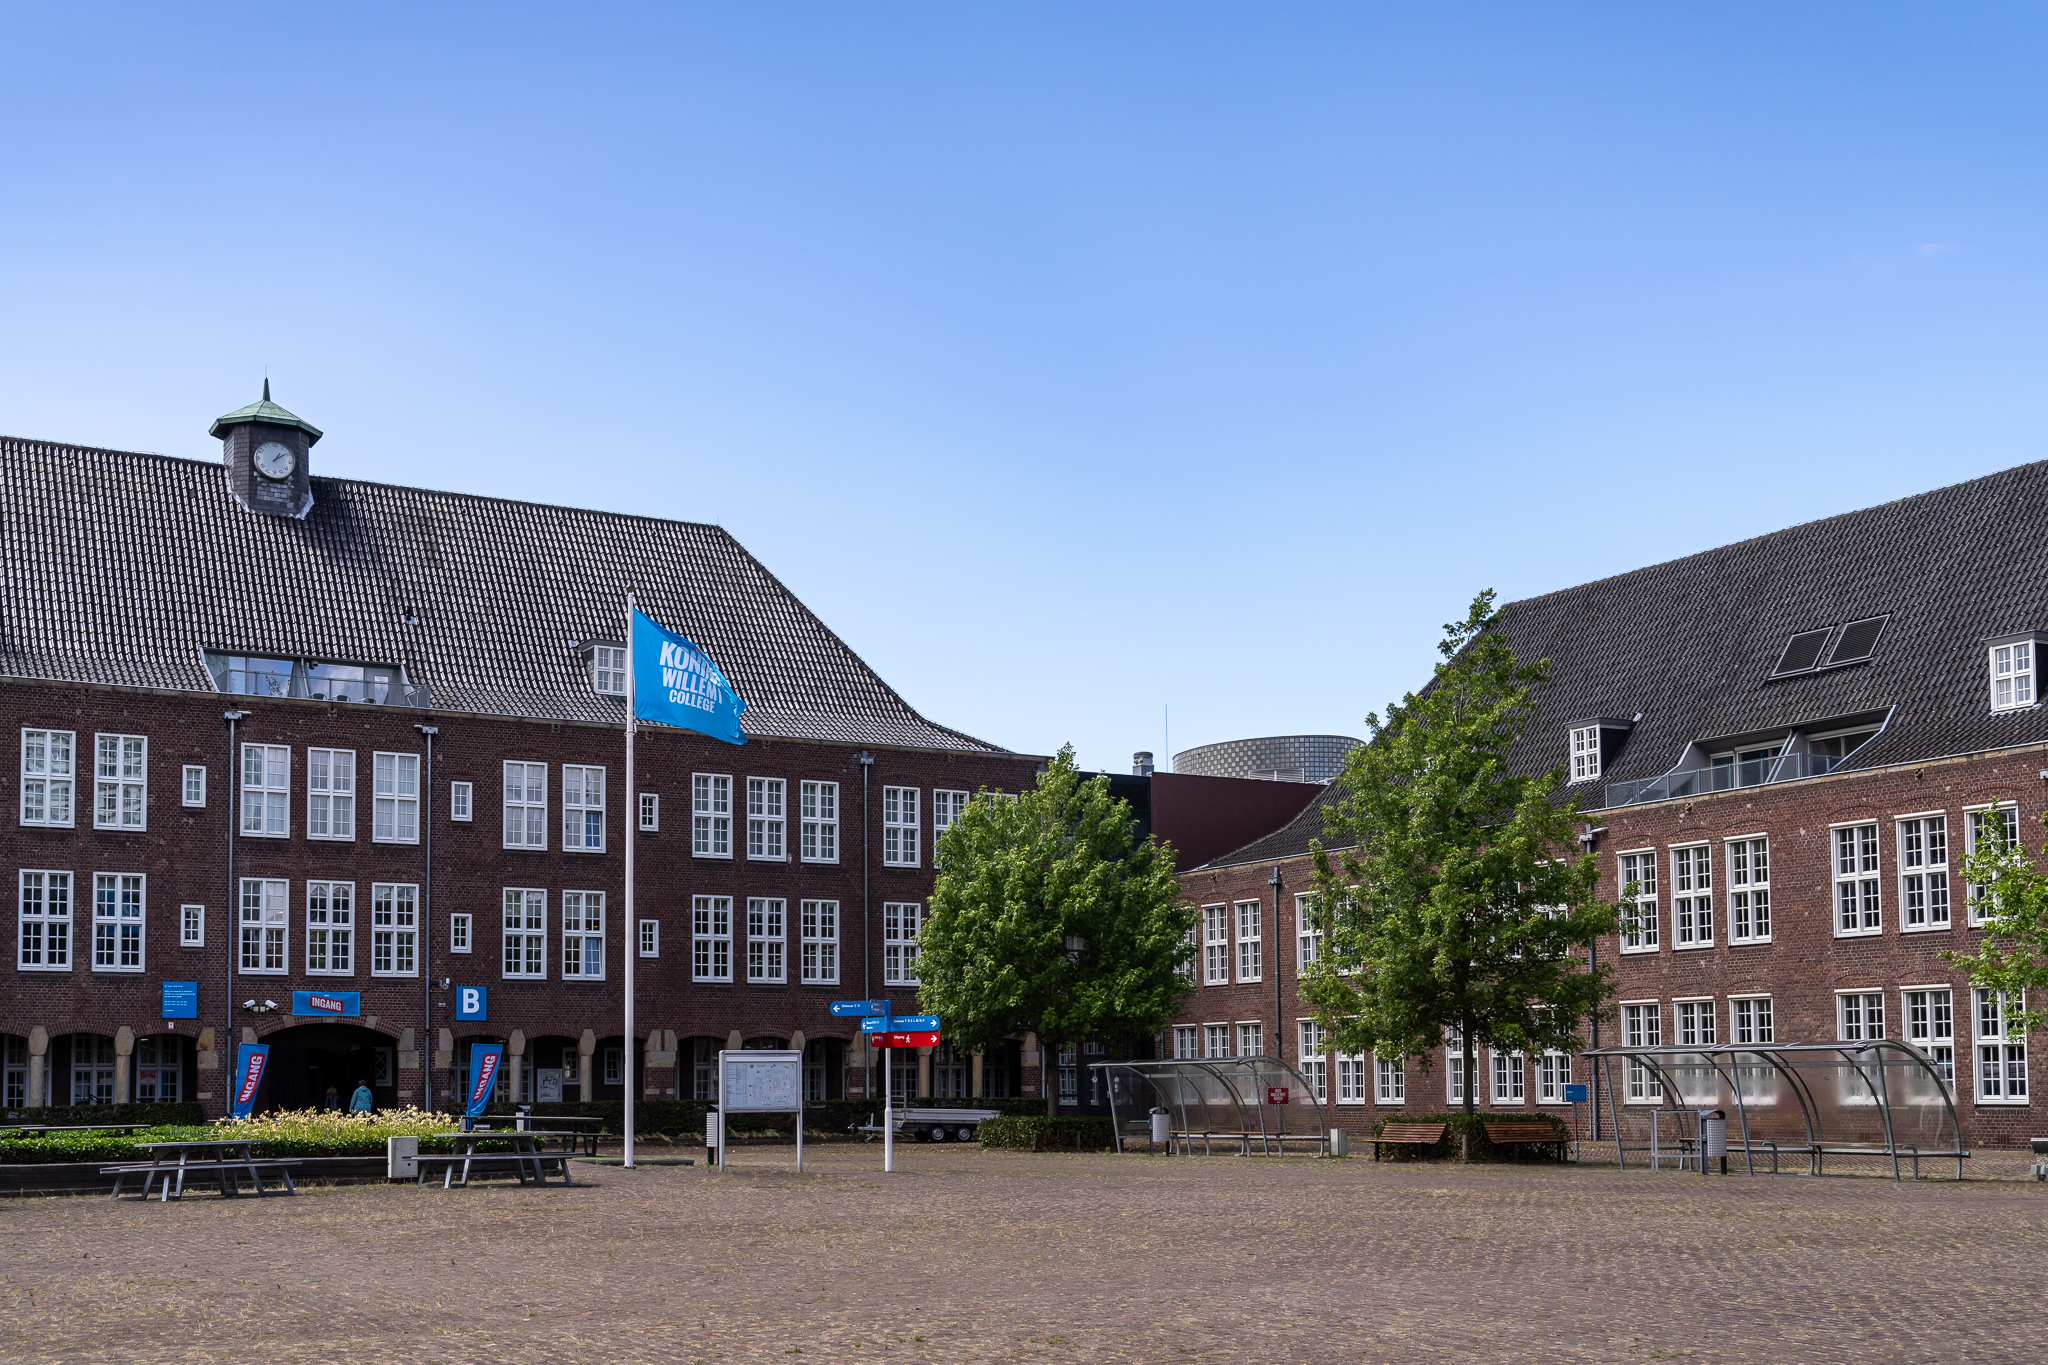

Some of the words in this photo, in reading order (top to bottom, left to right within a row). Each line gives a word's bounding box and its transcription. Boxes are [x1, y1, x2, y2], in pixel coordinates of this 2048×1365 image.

[662, 667, 717, 701] WILLEM
[669, 689, 715, 713] COLLEGE
[312, 997, 342, 1011] INGANG
[463, 989, 480, 1013] B
[240, 1056, 263, 1101] INGANG
[474, 1056, 496, 1100] INGANG
